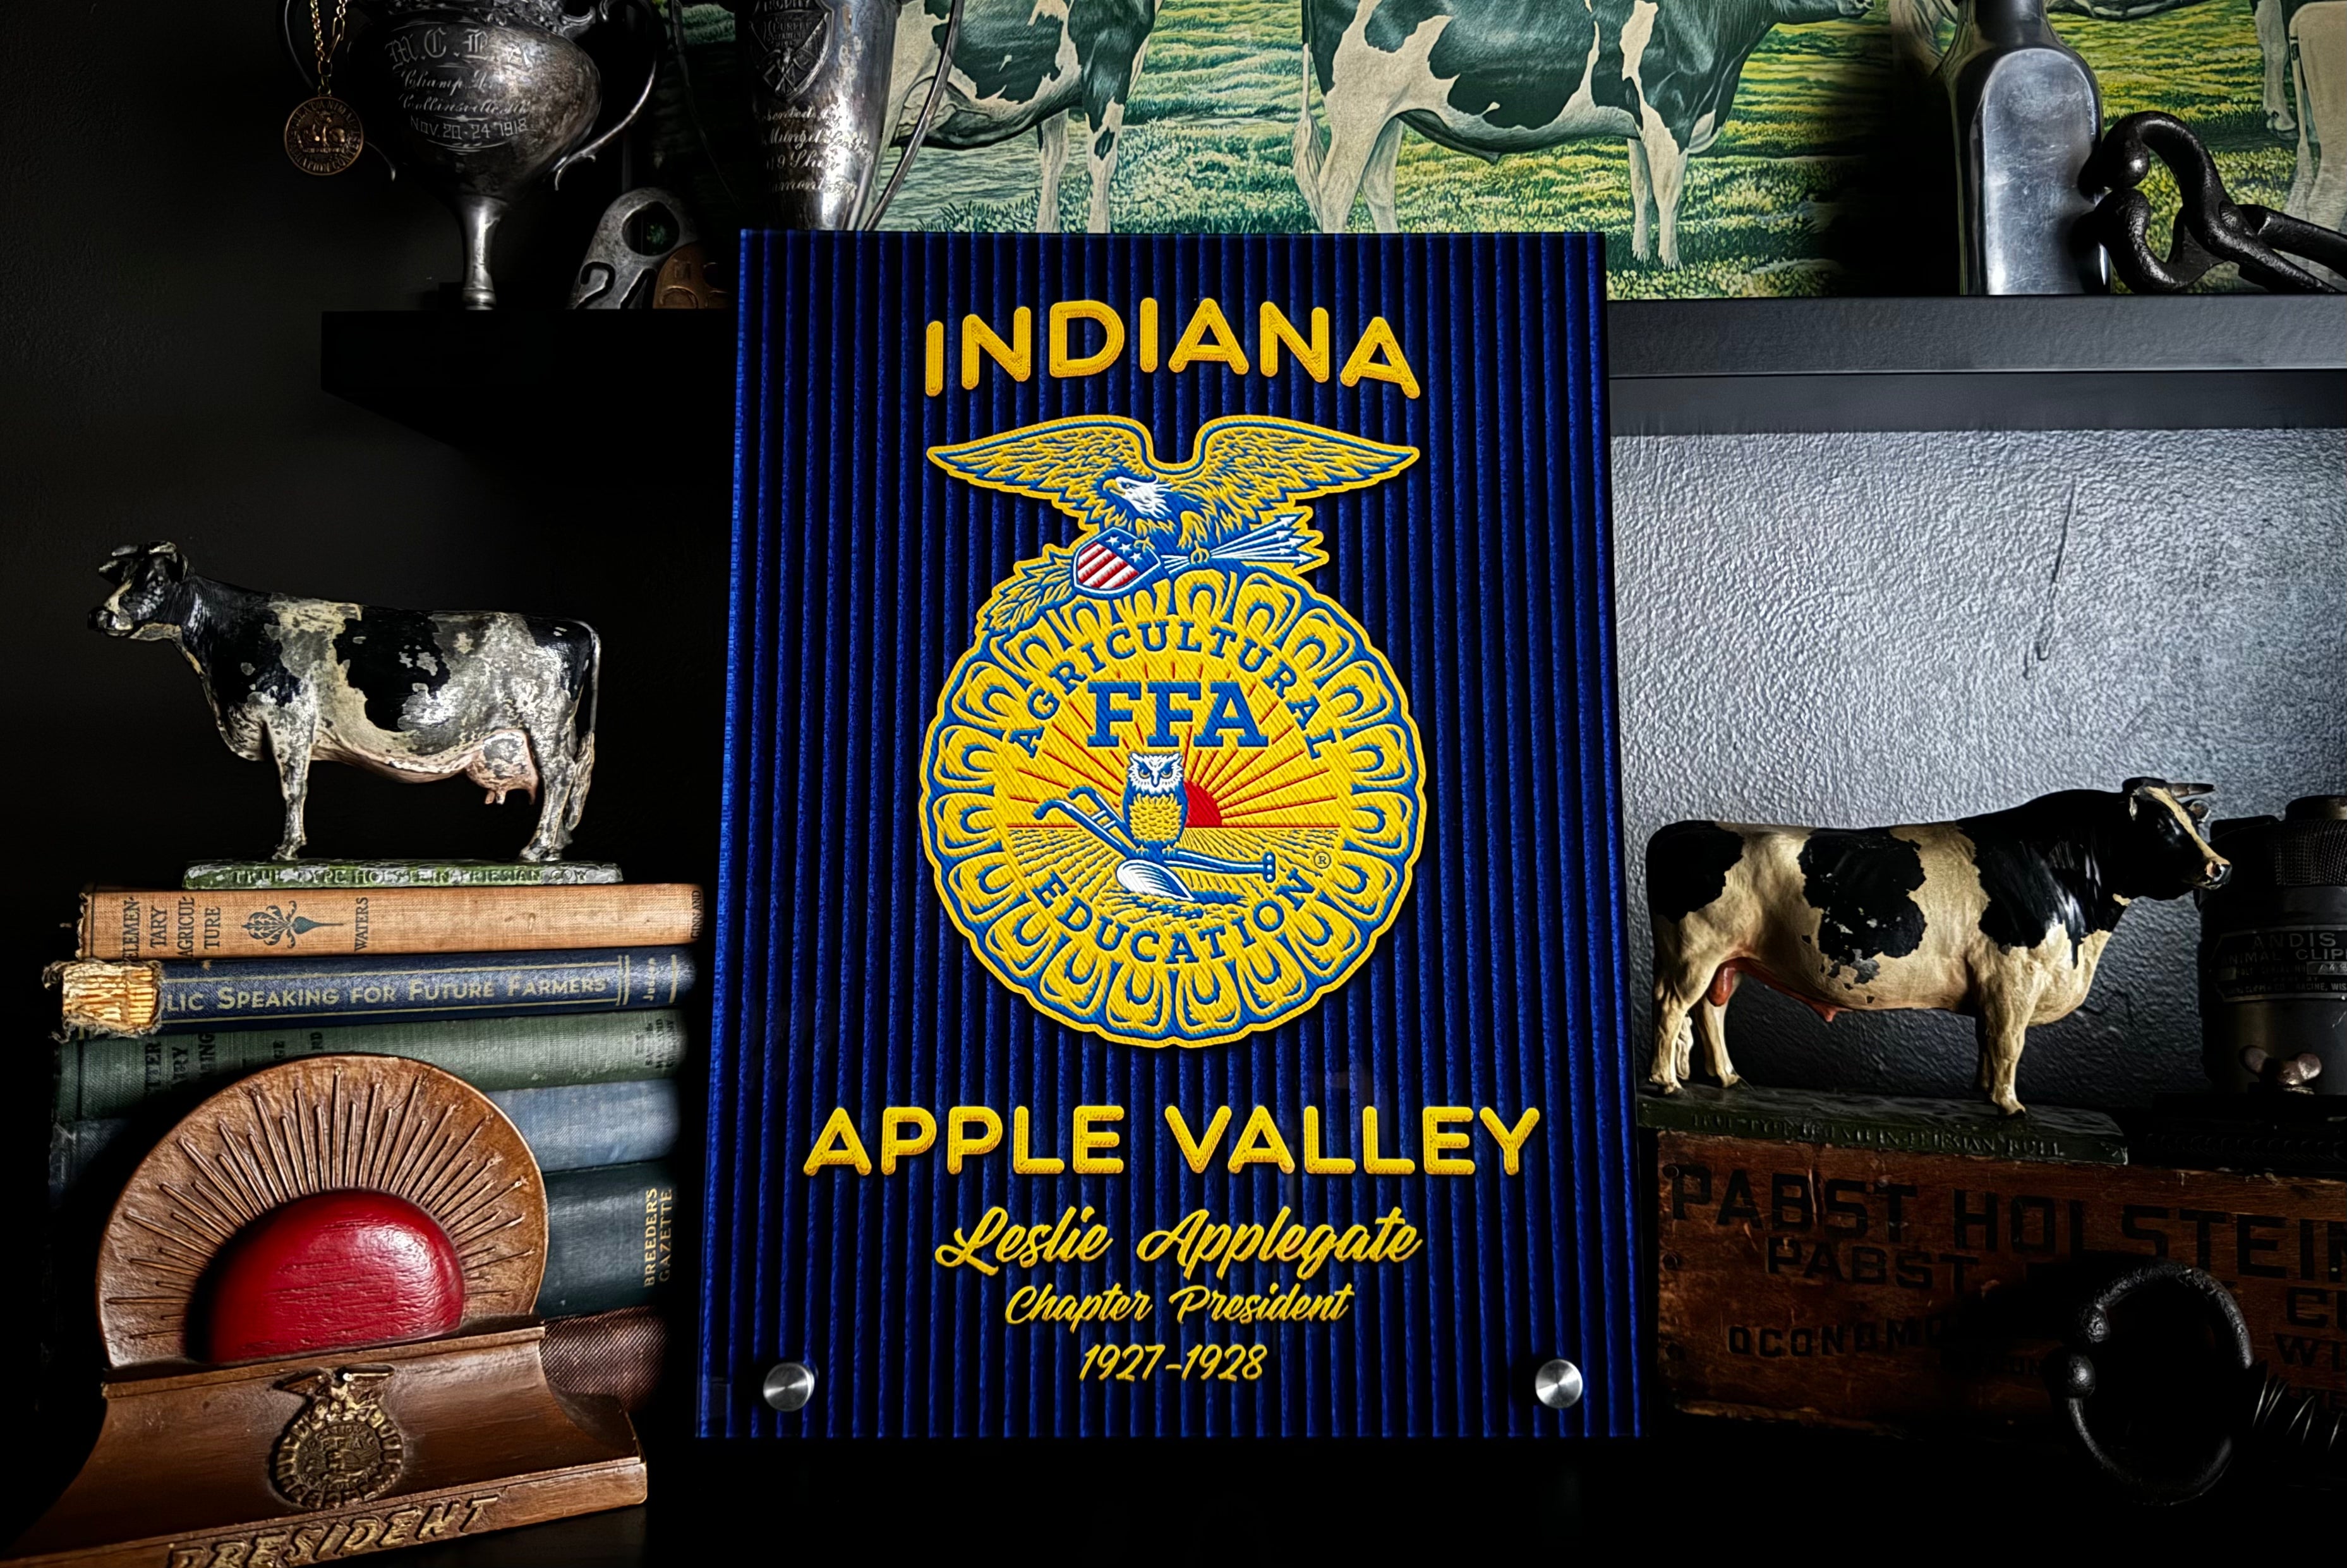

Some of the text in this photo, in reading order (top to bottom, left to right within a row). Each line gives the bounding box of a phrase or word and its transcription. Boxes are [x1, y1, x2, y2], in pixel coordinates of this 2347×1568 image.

[925, 298, 1421, 399] INDIANA
[1009, 620, 1337, 759] AGRICULTURAL
[1087, 682, 1269, 748] FFA
[150, 904, 167, 950] TARY
[204, 905, 221, 950] TURE
[354, 896, 370, 952] WATERS
[1032, 868, 1318, 965] EDUCATION
[2253, 932, 2337, 950] ANDIS
[2295, 948, 2347, 961] CLIP
[162, 992, 204, 1012] LIC
[803, 1105, 1540, 1176] APPLE VALLEY
[659, 1188, 673, 1282] GAZETTE
[1663, 1163, 1918, 1244] PABST
[934, 1205, 1423, 1280] Leslie Applegate
[1765, 1236, 1980, 1299] PABST
[1005, 1282, 1356, 1334] Chapter President
[1078, 1343, 1267, 1382] 1927-1928
[167, 1496, 500, 1568] PRESIDENT
